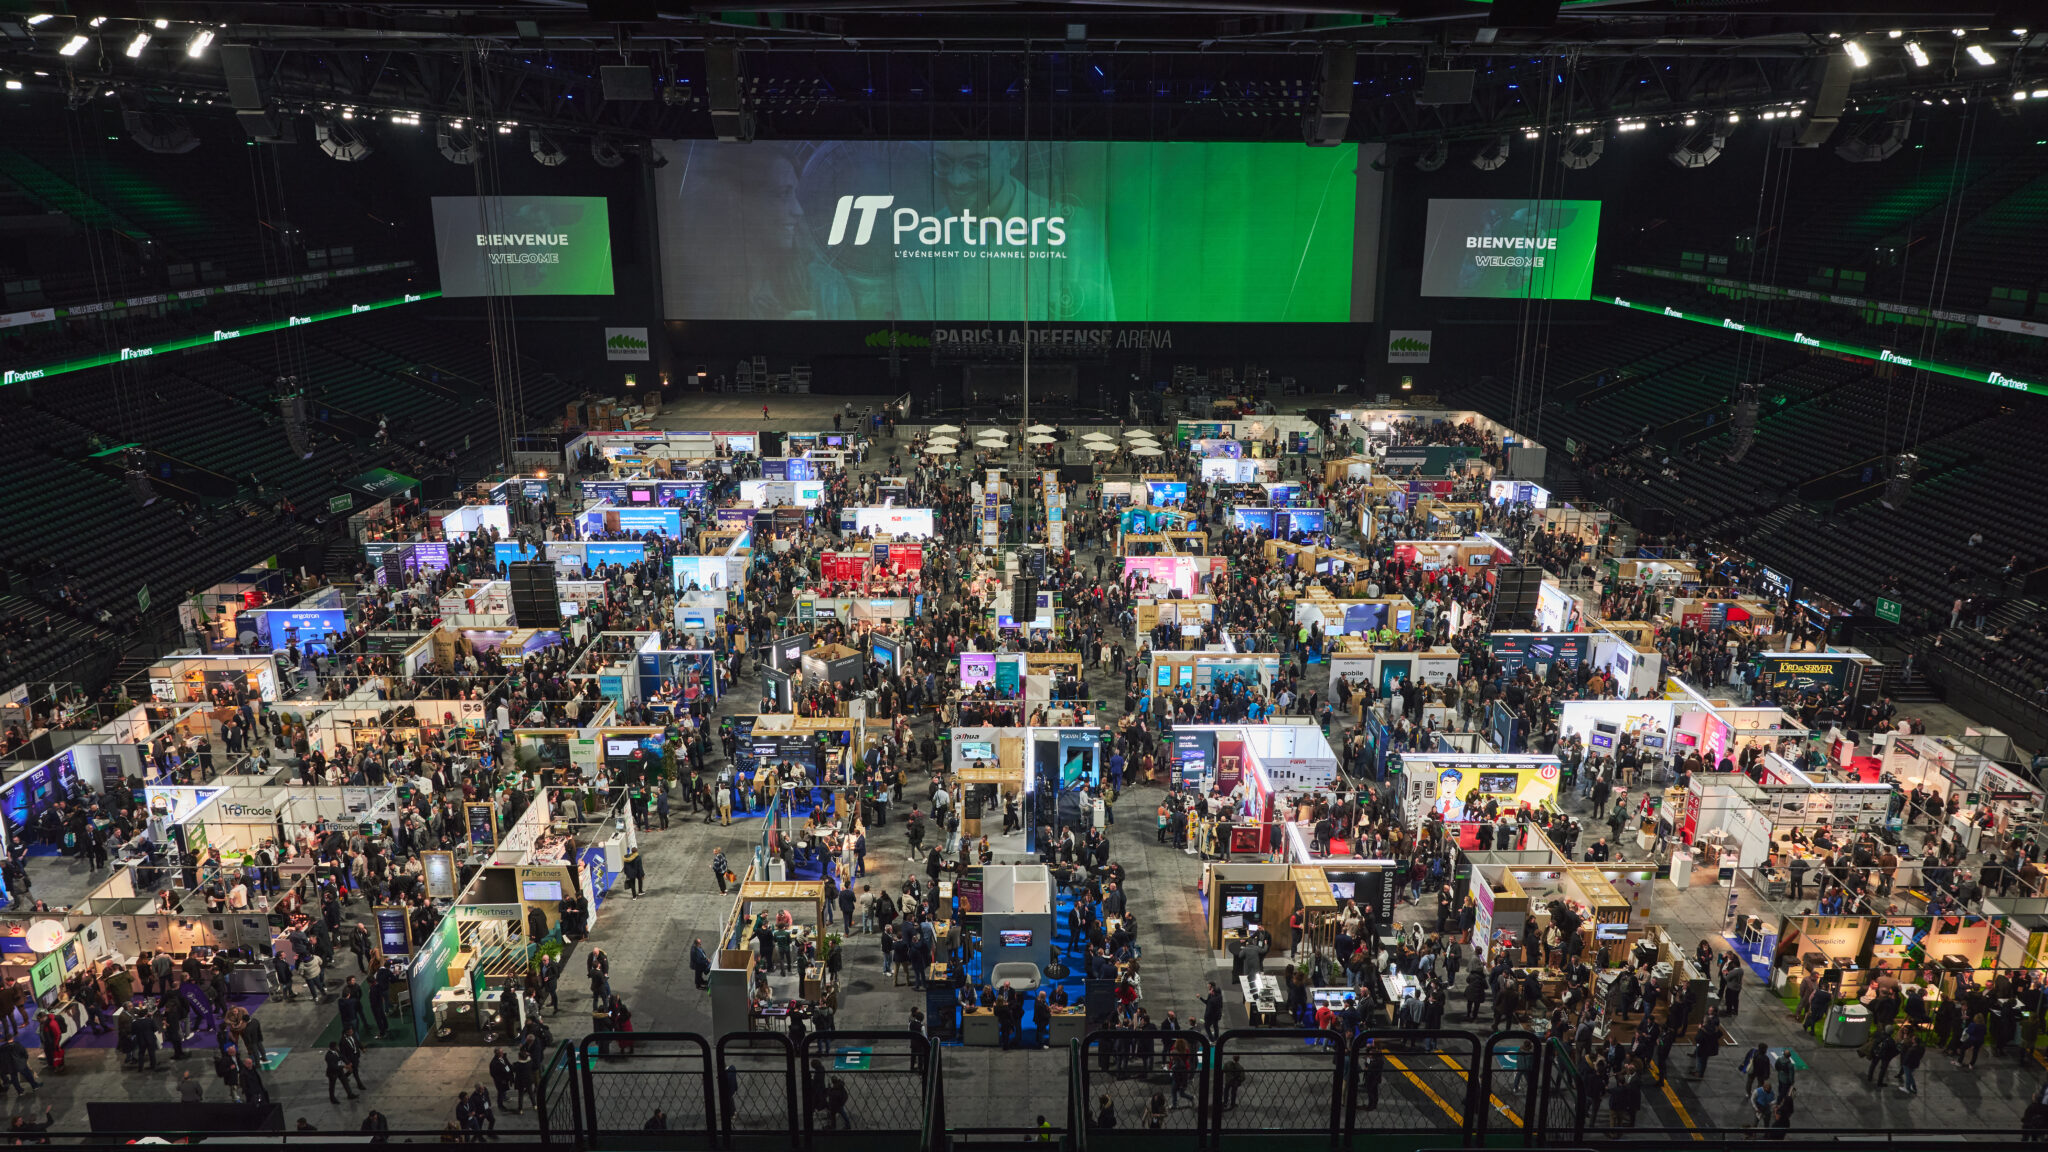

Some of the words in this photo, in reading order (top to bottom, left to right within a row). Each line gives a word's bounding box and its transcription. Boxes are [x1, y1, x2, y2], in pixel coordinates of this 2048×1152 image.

[827, 195, 894, 246] IT
[893, 207, 1067, 246] Partners
[476, 234, 569, 246] BIENVENUE
[1466, 236, 1558, 250] BIENVENUE
[488, 253, 560, 265] WELCOME
[894, 249, 960, 258] L'ÉVÉNEMENT
[963, 250, 977, 259] DU
[979, 250, 1026, 259] CHANNEL
[1029, 251, 1068, 259] DIGITAL
[1475, 255, 1545, 268] WELCOME
[214, 330, 223, 342] IT
[936, 329, 993, 344] PARIS
[997, 329, 1022, 344] LA
[1027, 329, 1113, 347] DEFENSE
[1116, 329, 1173, 349] ARENA
[1793, 332, 1804, 343] IT
[121, 347, 131, 360] IT
[1879, 349, 1892, 361] IT
[4, 370, 16, 385] IT
[14, 369, 45, 383] Partners
[1987, 371, 2001, 385] IT
[1998, 376, 2028, 391] Partners
[1803, 663, 1834, 675] SERVER
[1381, 871, 1394, 918] SAMSUNG
[463, 906, 477, 916] IT
[477, 907, 513, 916] Partners
[1813, 938, 1846, 946] Simplicité
[845, 1051, 862, 1064] E
